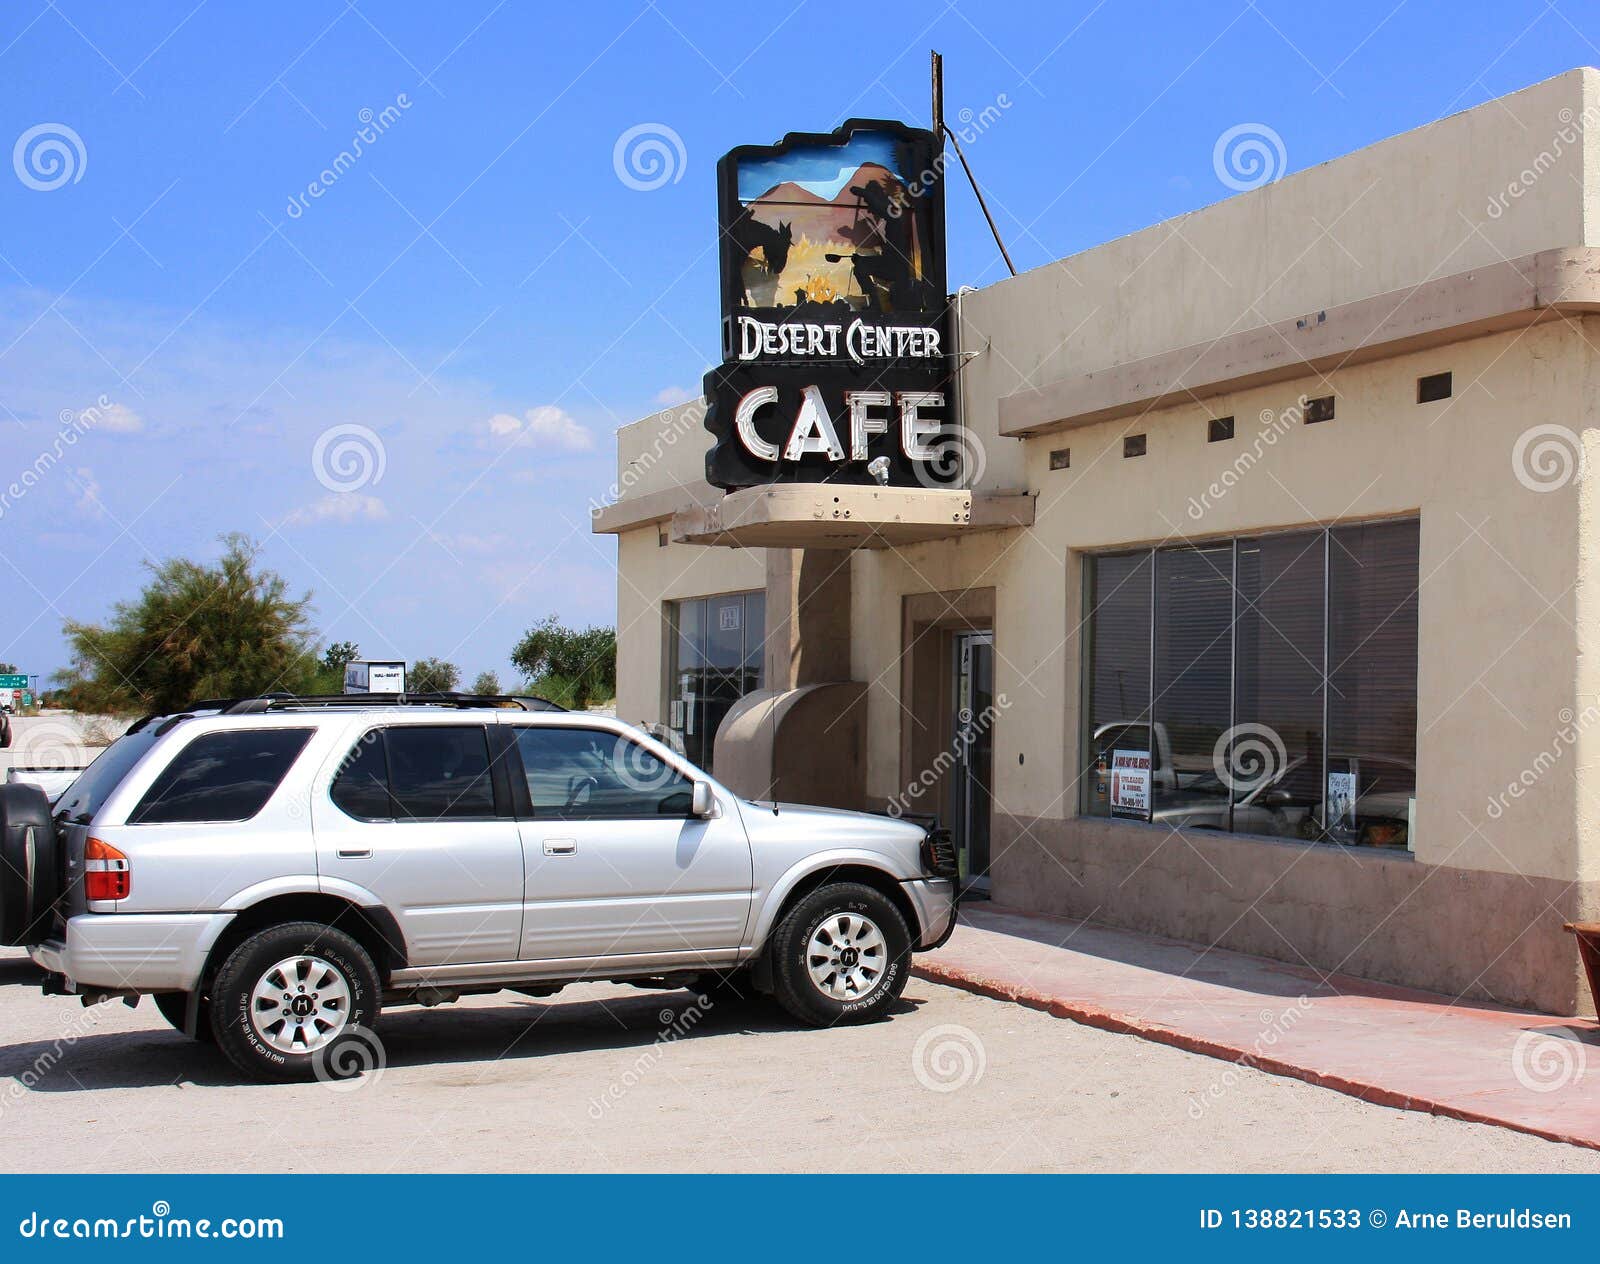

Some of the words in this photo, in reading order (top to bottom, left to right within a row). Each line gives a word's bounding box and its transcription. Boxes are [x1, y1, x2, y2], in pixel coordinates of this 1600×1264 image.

[738, 316, 841, 361] DESERT
[846, 318, 943, 366] CENTER
[735, 384, 945, 462] CAFE
[1120, 775, 1144, 784] UNLEADED
[842, 963, 898, 1012] MICHELIN
[240, 992, 285, 1064] MICHELIN
